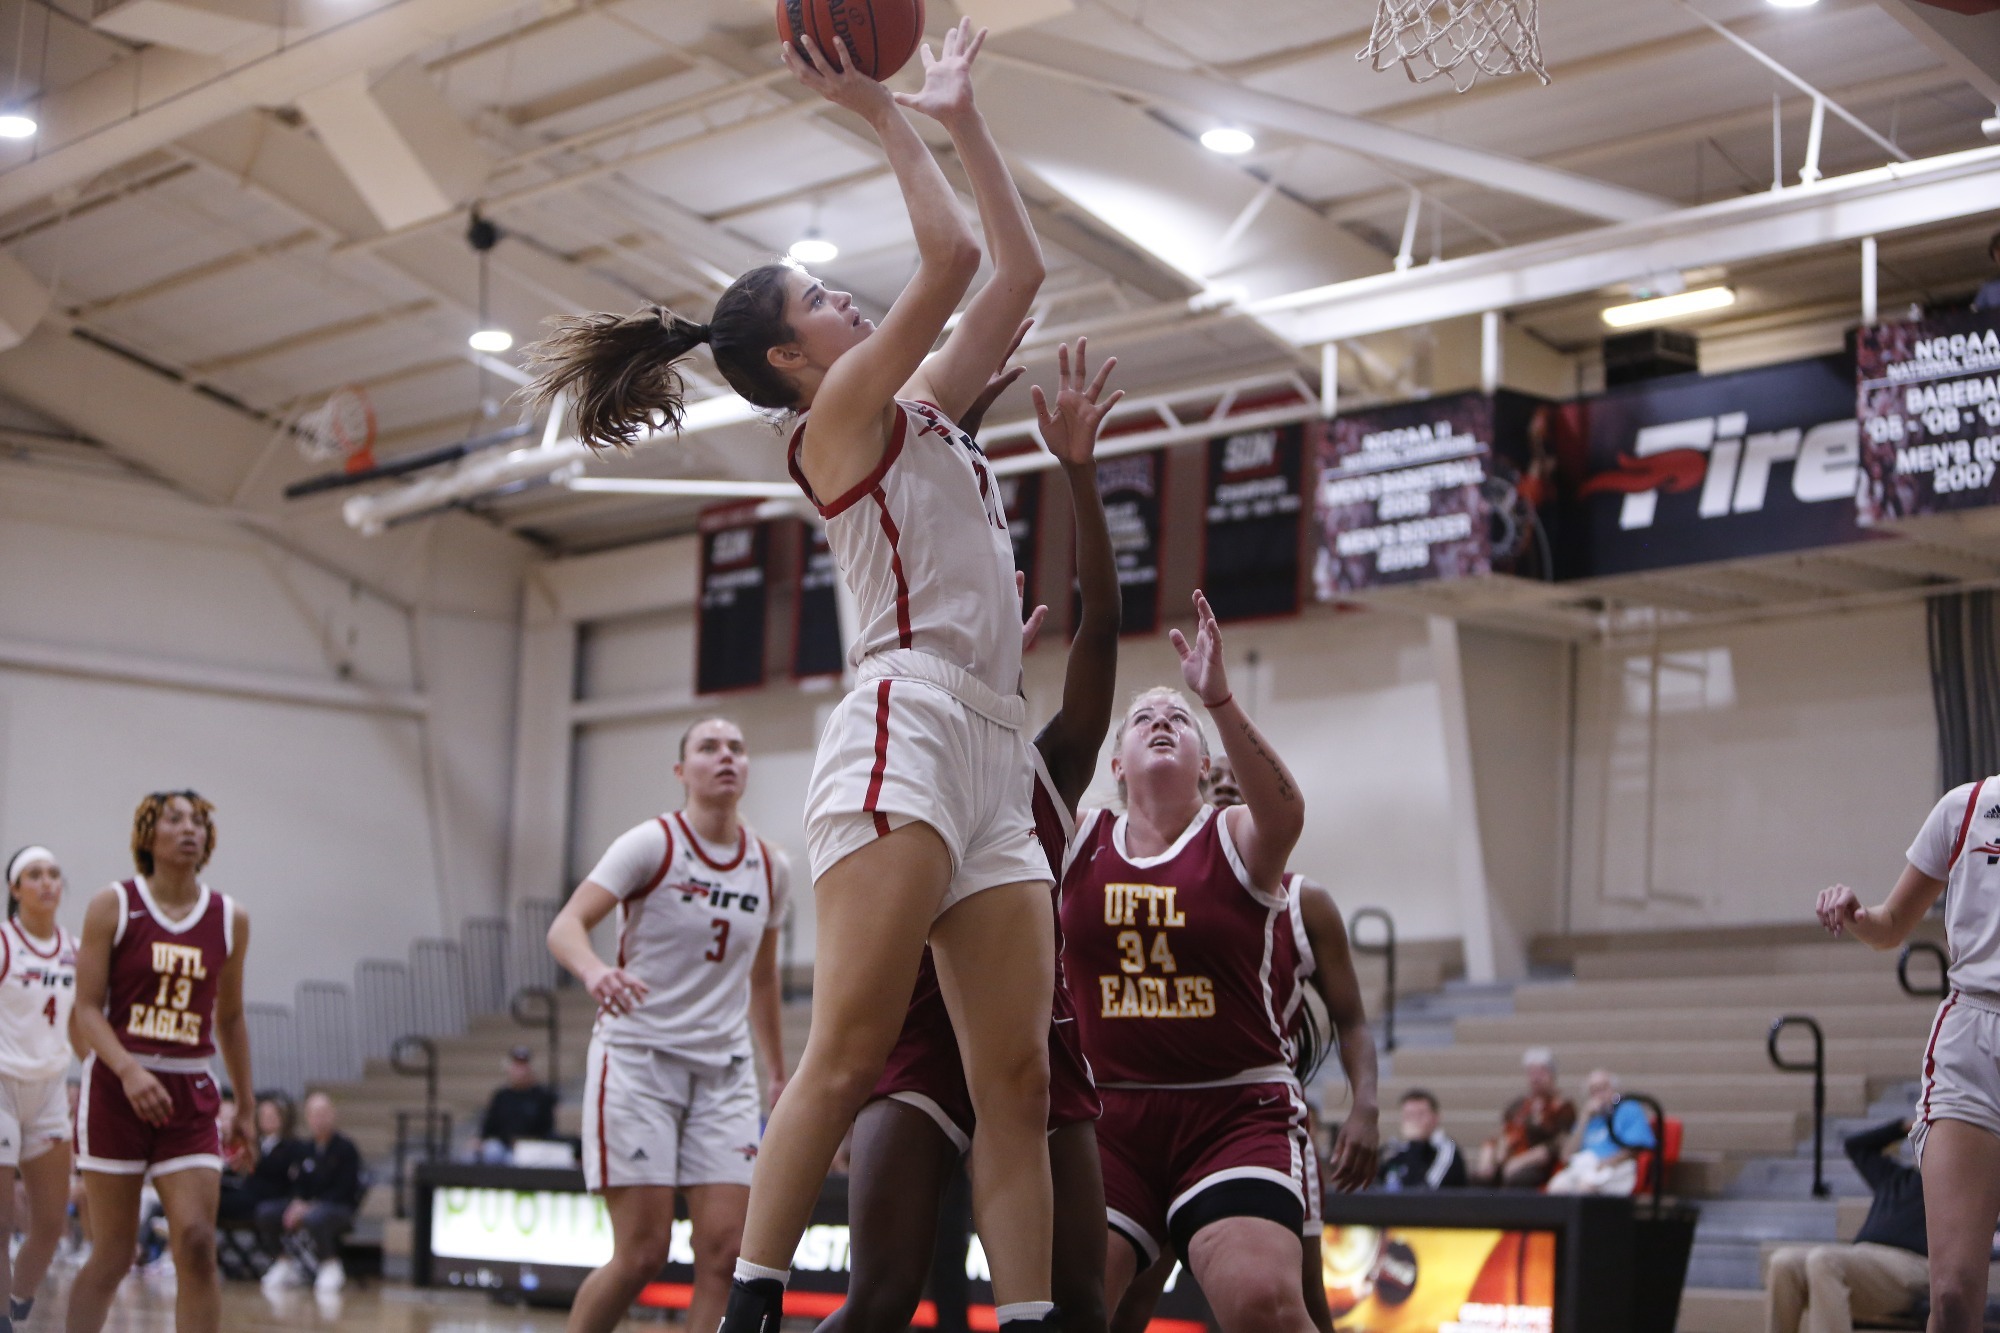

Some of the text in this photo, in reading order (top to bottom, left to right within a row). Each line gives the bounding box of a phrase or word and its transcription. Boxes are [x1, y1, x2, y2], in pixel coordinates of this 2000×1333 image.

[1905, 375, 2000, 415] BASEBA
[1619, 410, 1860, 531] Fire
[682, 877, 759, 913] Fire
[1104, 882, 1186, 928] UFTL
[151, 941, 207, 980] UFTL
[705, 918, 730, 963] 3
[1117, 930, 1177, 974] 34
[23, 967, 73, 988] Fire
[154, 975, 192, 1011] 13
[1099, 975, 1216, 1019] EAGLES
[43, 994, 56, 1027] 4
[126, 1003, 202, 1046] EAGLES
